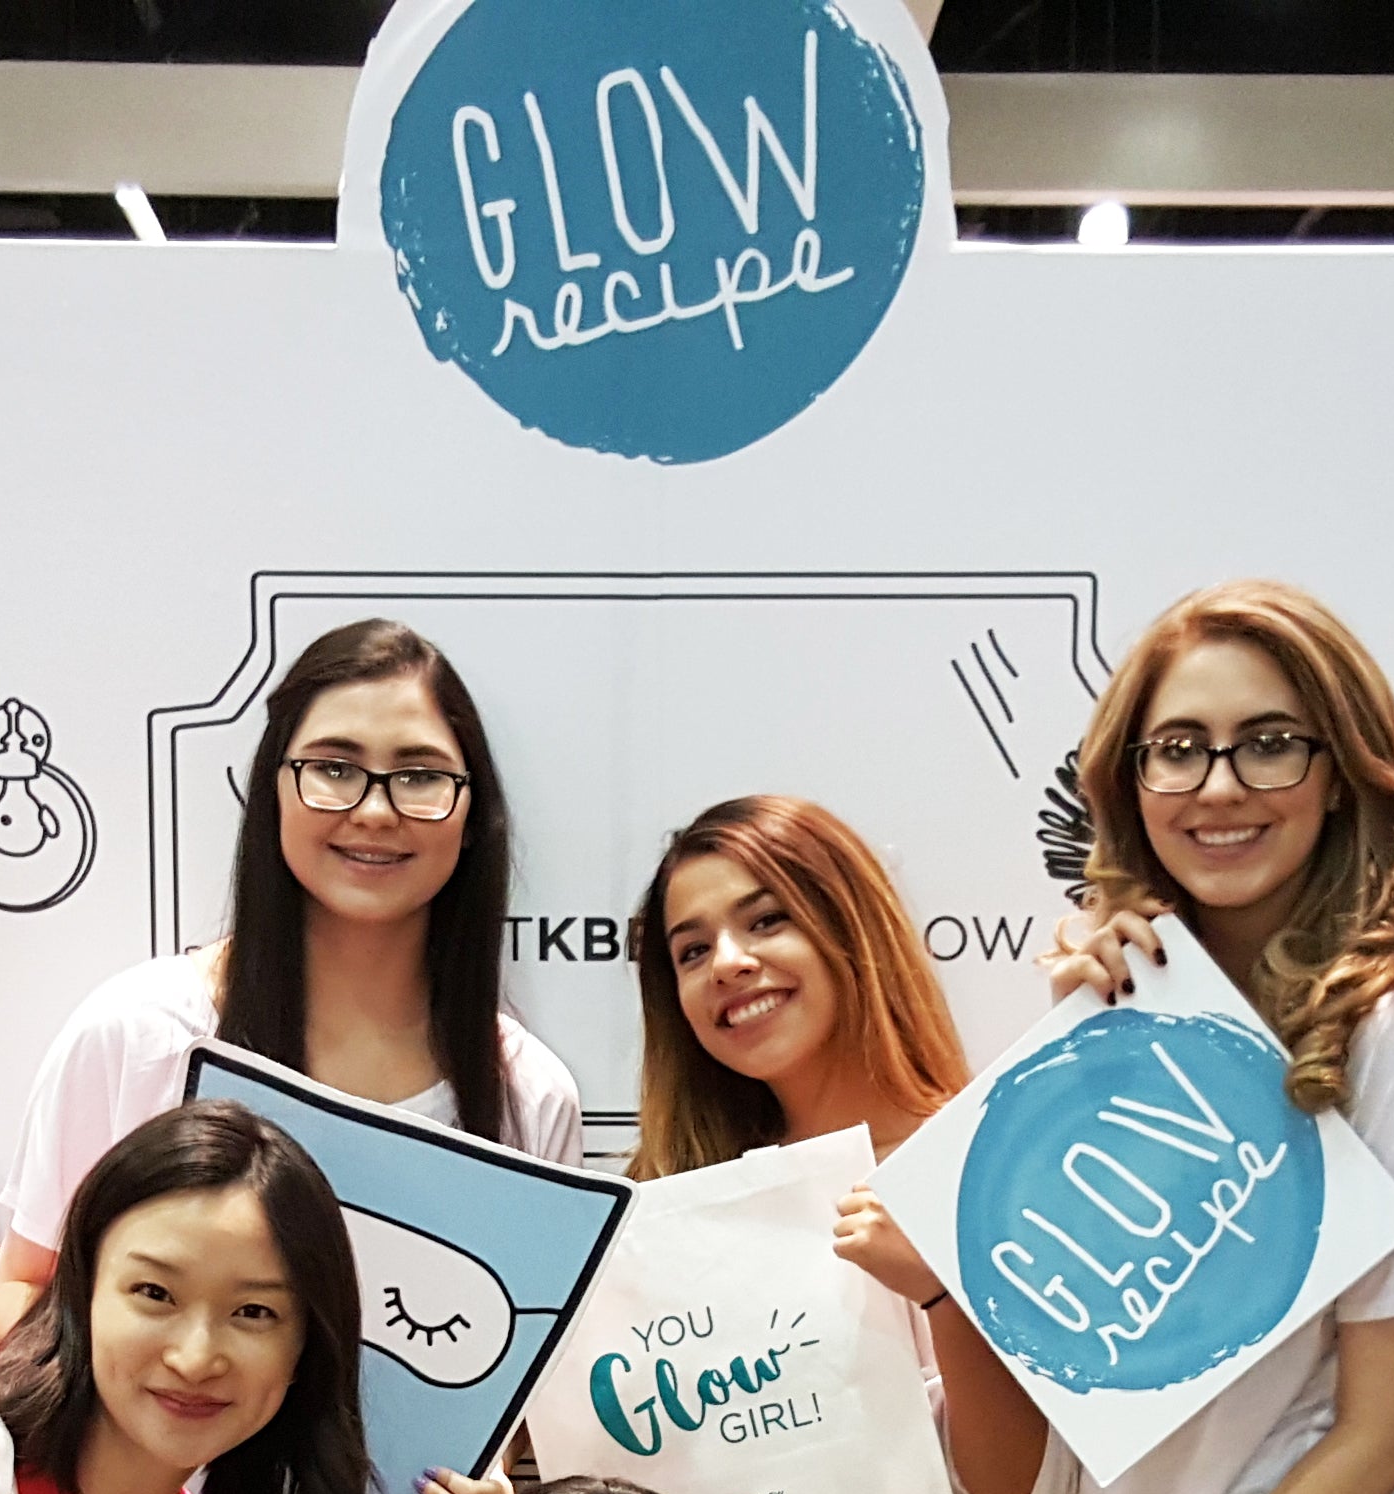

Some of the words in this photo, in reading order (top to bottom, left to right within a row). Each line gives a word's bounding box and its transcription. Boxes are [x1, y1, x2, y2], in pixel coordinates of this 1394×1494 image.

[452, 29, 818, 290] GLOW
[492, 227, 854, 357] recipe
[990, 1041, 1235, 1333] GLOW
[1095, 1140, 1287, 1366] recipe
[631, 1305, 714, 1353] YOU
[589, 1343, 791, 1457] Glow
[719, 1392, 823, 1444] GIRL!
